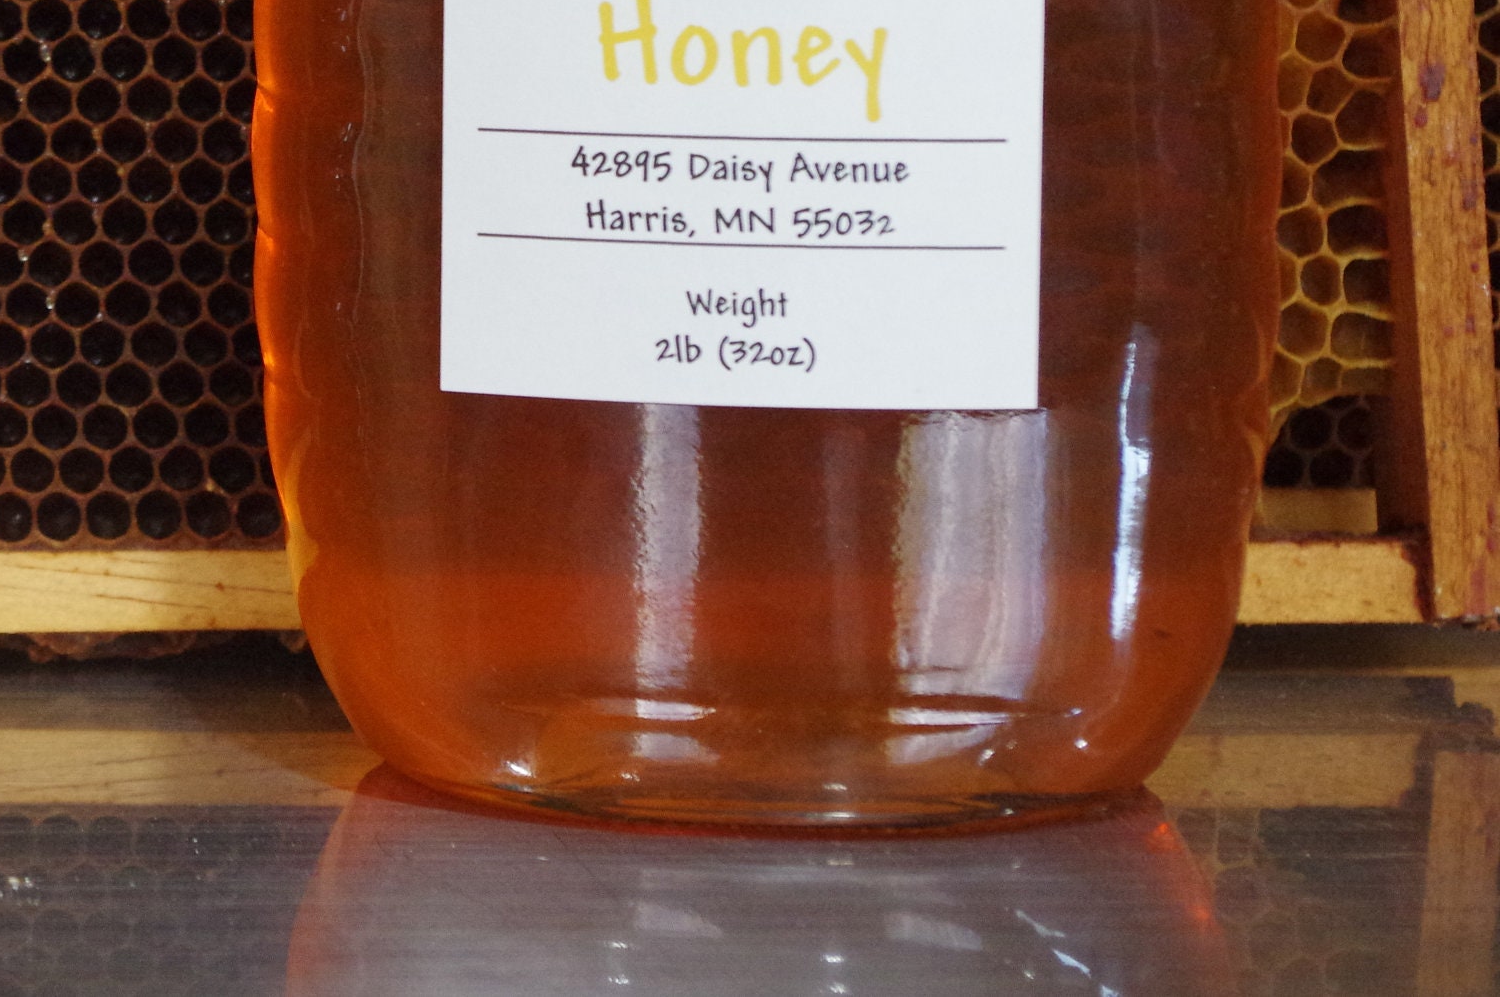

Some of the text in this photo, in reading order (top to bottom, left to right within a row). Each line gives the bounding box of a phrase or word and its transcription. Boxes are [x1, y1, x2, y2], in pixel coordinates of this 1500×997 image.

[571, 145, 909, 193] 42895 Daisy Avenue
[586, 199, 894, 239] Harris, MN 55032
[686, 288, 787, 328] Weight
[655, 334, 816, 373] 2lb (32oz)
